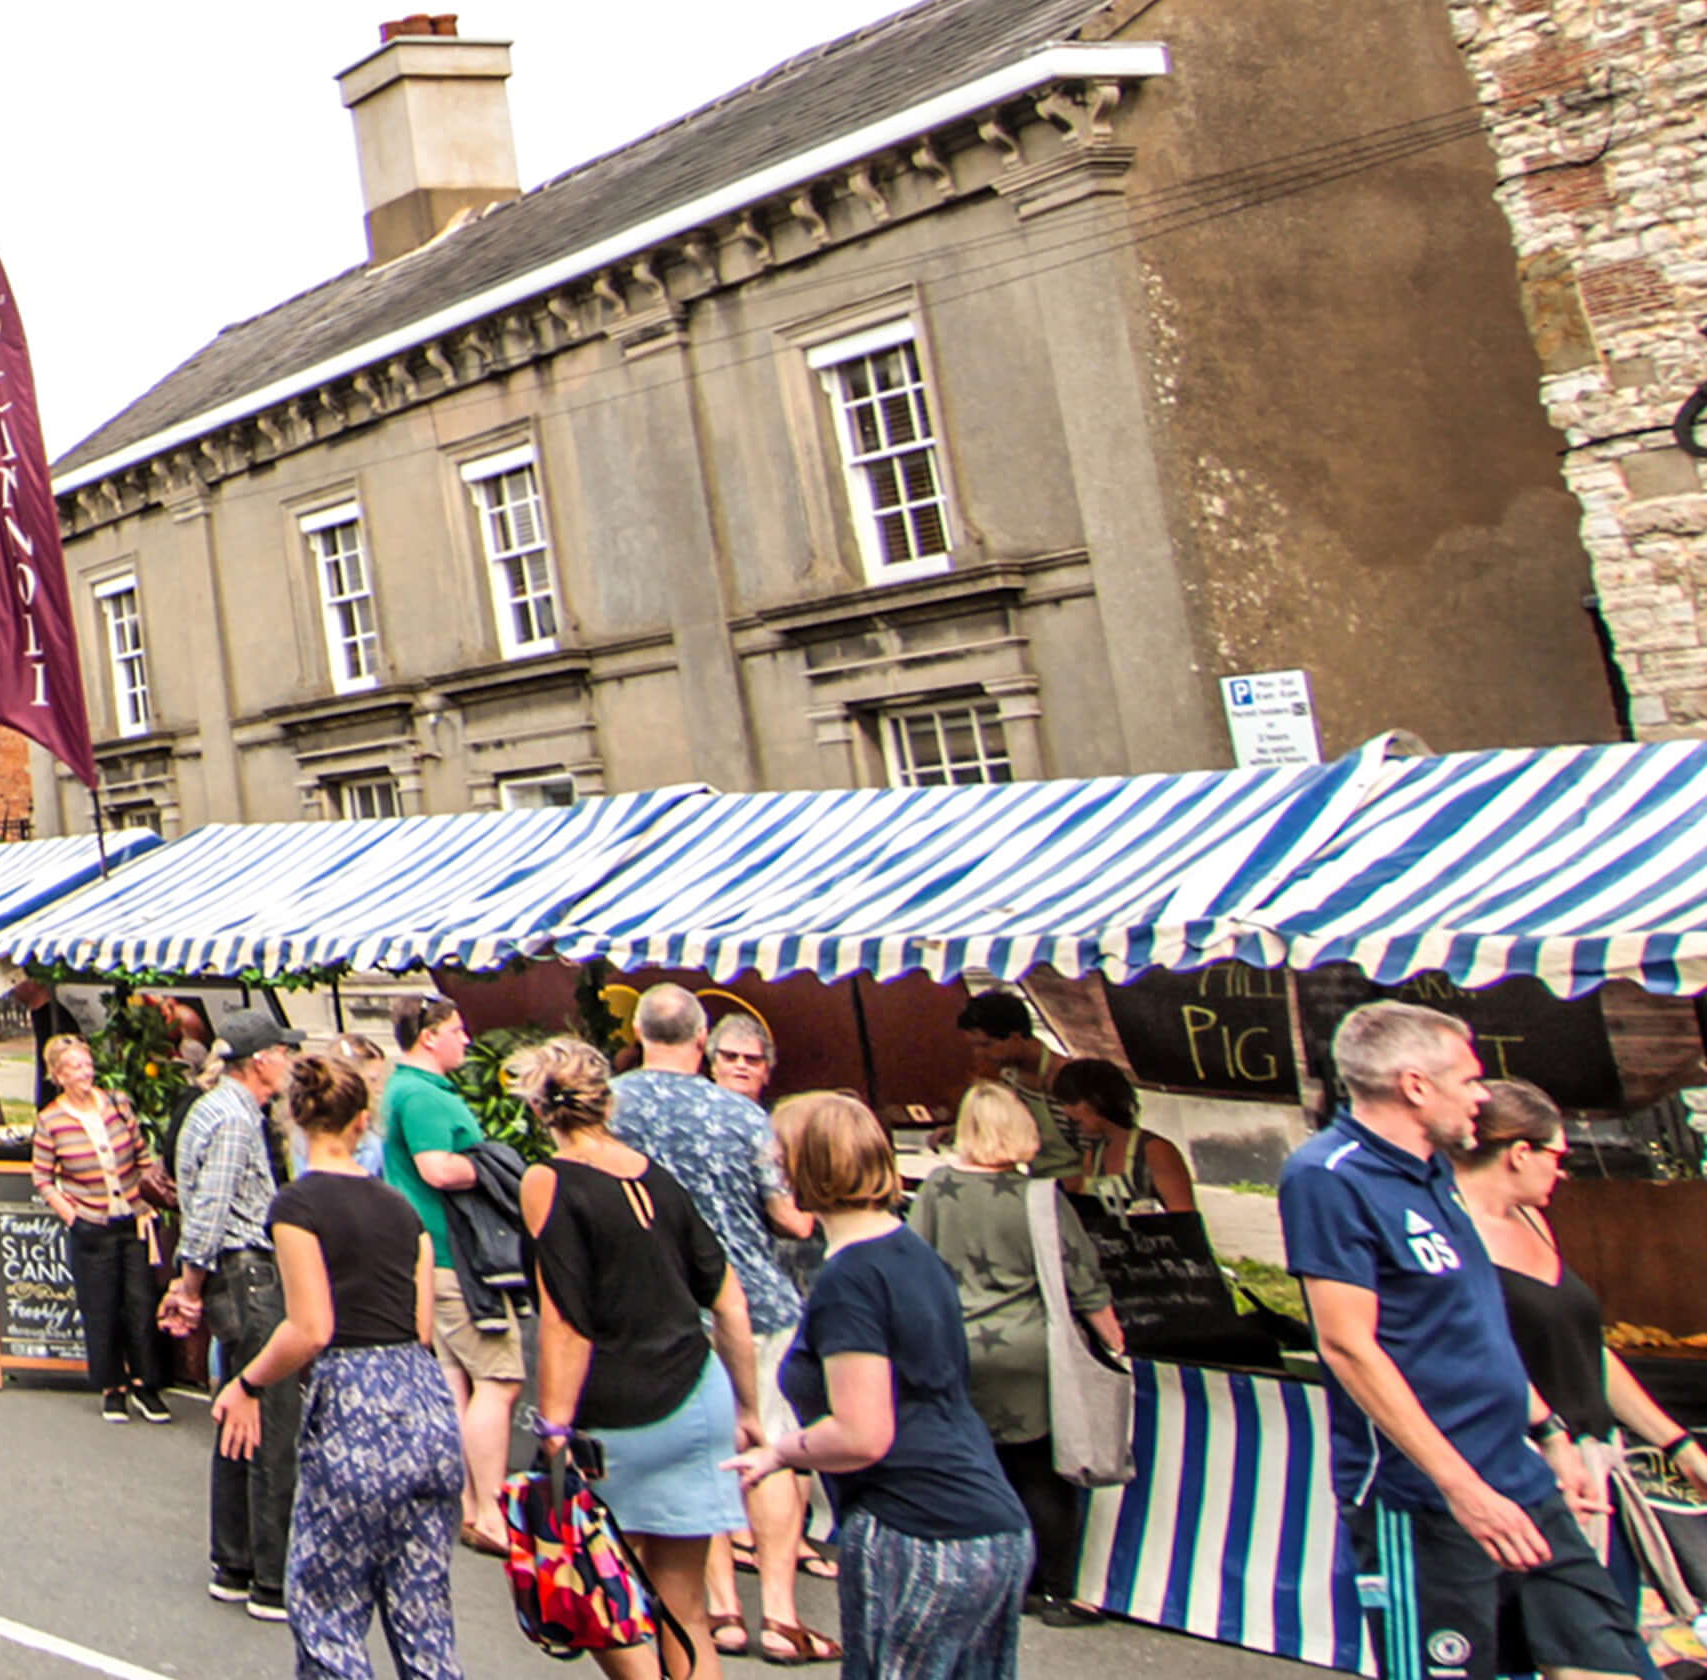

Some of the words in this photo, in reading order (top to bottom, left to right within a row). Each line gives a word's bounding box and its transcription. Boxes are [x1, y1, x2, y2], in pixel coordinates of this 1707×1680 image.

[1181, 1004, 1278, 1082] PIG
[3, 1260, 74, 1283] CANN
[1407, 1232, 1463, 1276] DS
